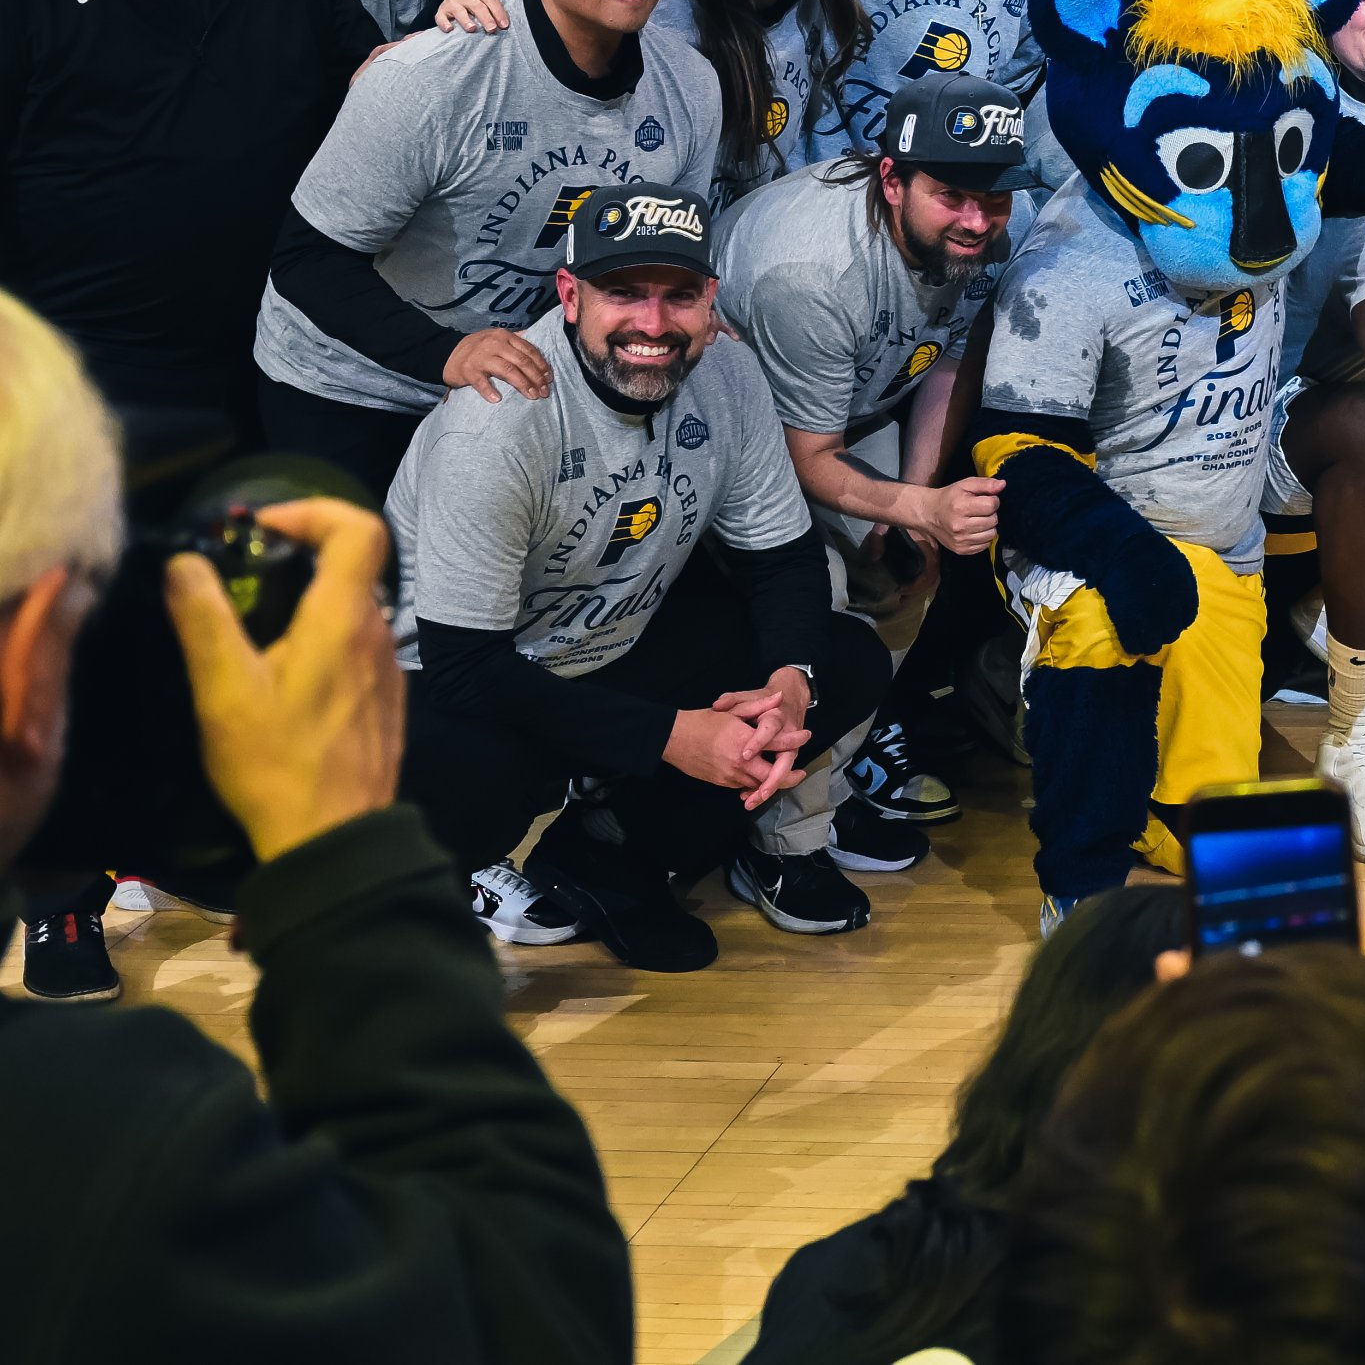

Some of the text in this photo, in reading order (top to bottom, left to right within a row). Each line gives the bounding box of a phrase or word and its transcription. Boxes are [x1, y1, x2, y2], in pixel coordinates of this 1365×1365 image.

[635, 127, 665, 145] EASTERN
[477, 145, 588, 246] INDIANA
[614, 196, 704, 242] Finals
[678, 424, 710, 442] EASTERN
[544, 459, 645, 575] INDIANA
[542, 654, 604, 671] HAMPIONS
